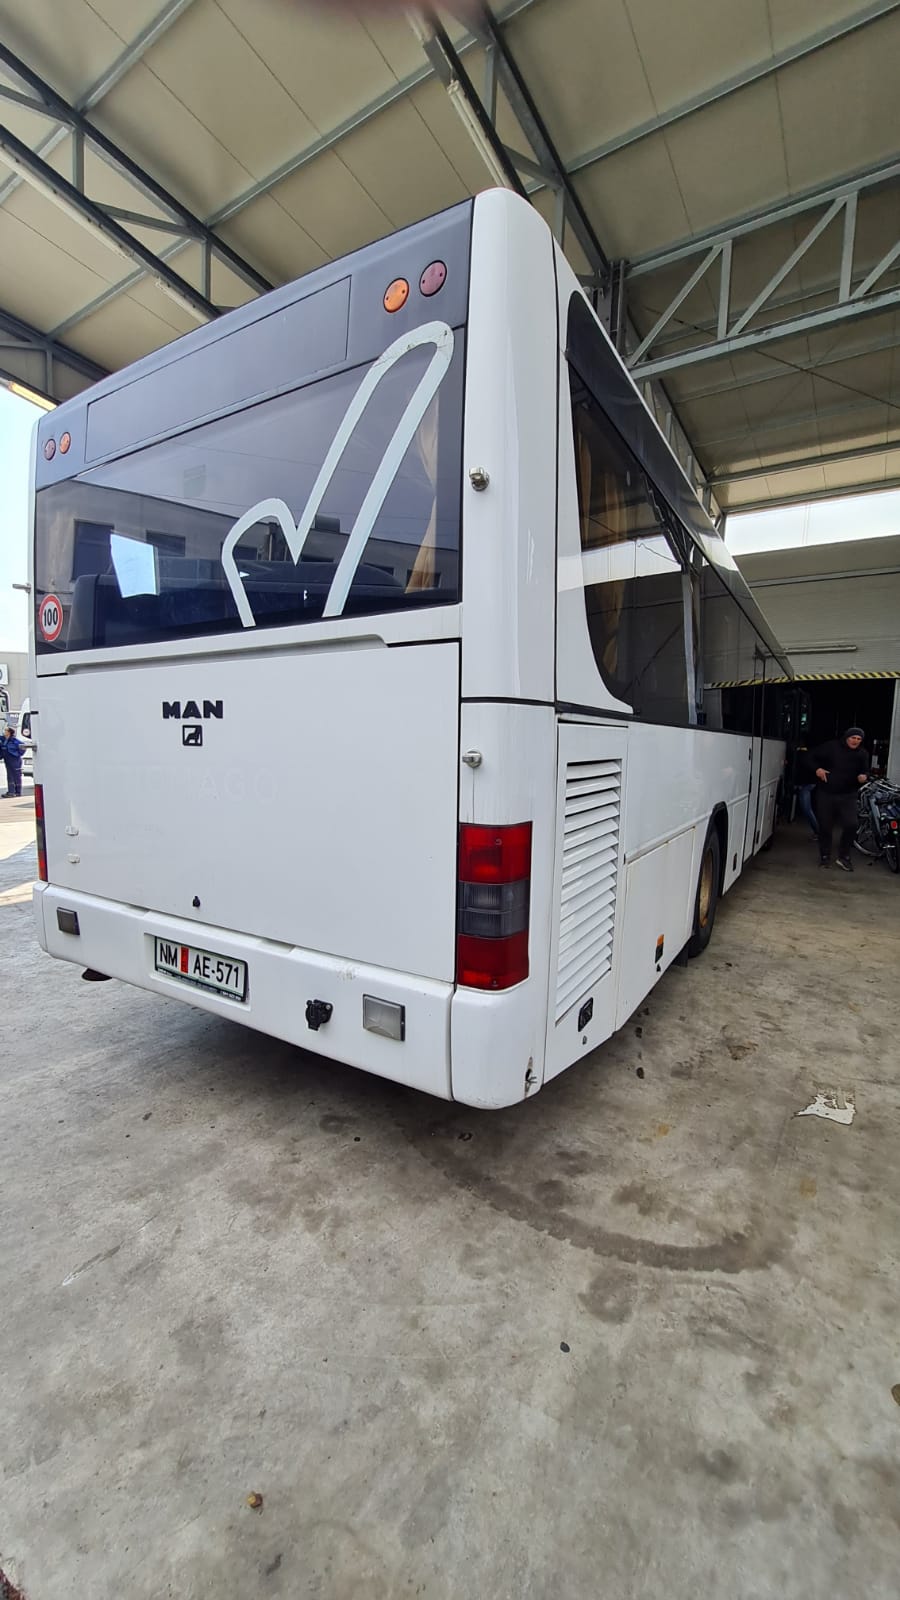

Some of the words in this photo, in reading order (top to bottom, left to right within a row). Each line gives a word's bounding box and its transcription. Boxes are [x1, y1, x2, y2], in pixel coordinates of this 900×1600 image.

[44, 607, 58, 627] 100
[162, 700, 223, 719] MAN
[160, 942, 178, 968] NM
[193, 953, 239, 988] AE-571
